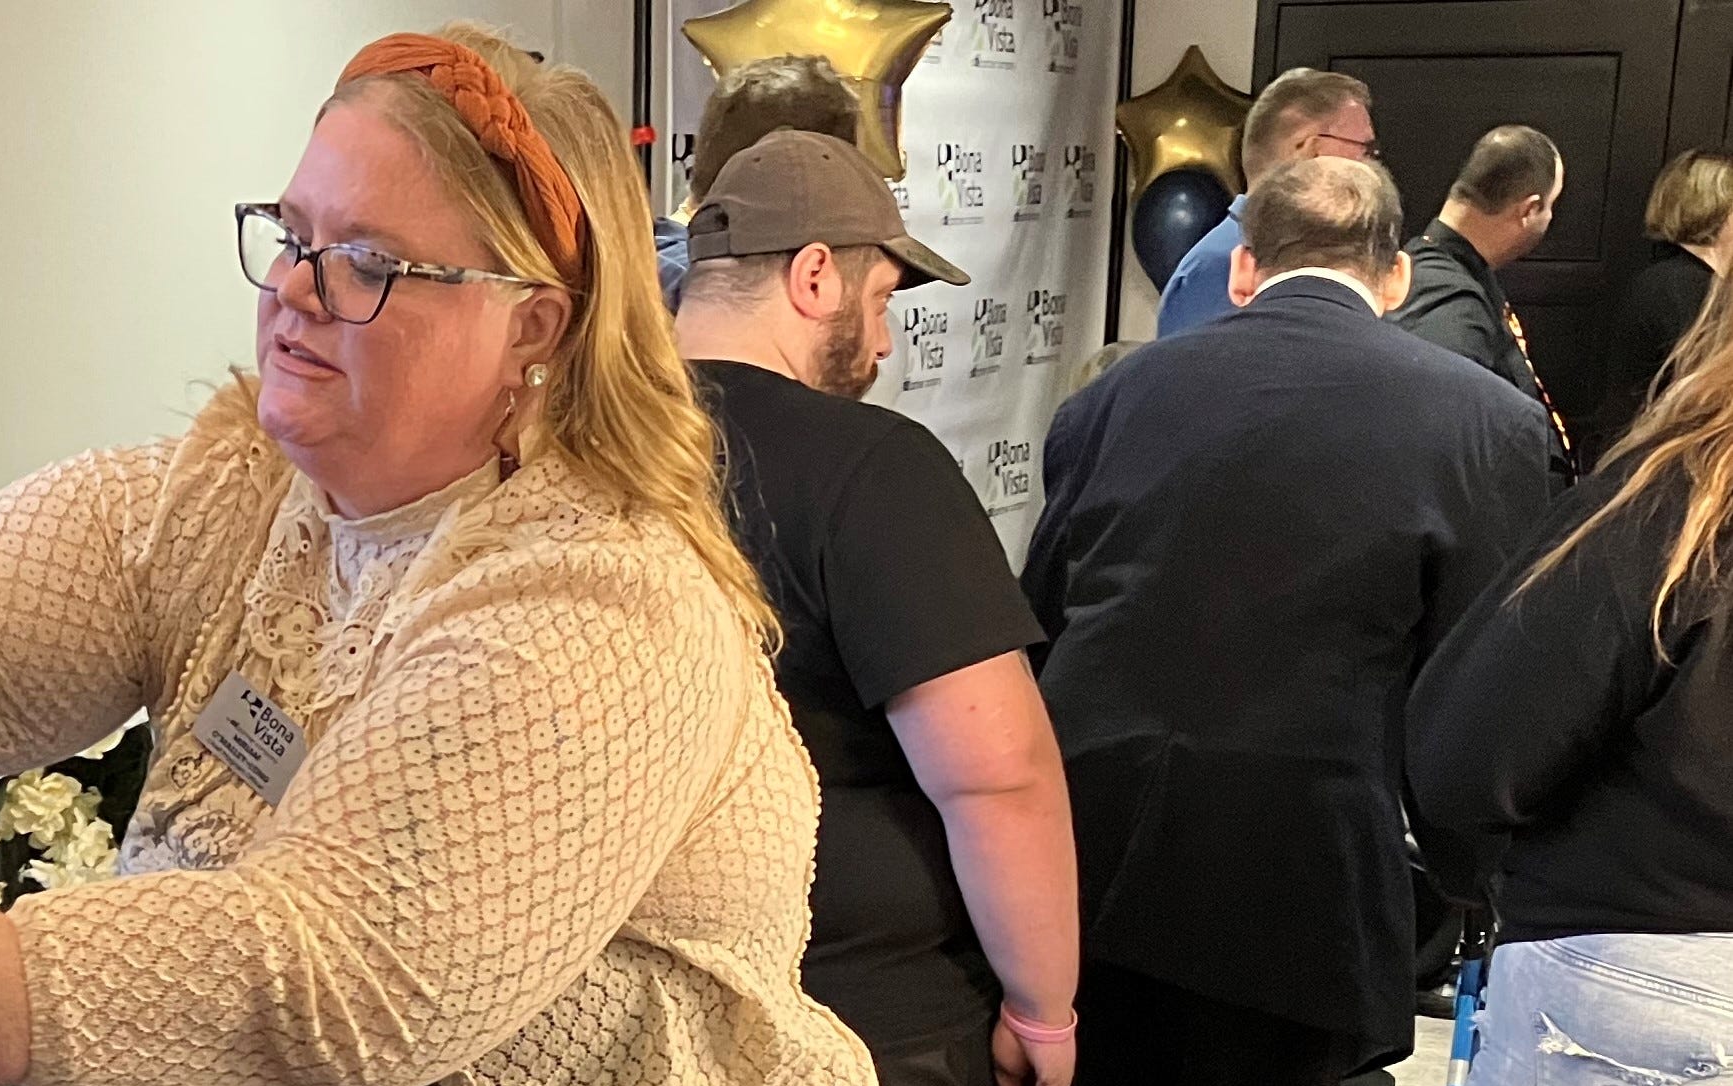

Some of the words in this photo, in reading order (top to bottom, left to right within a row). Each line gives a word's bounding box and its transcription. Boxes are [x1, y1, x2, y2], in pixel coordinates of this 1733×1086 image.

[988, 23, 1015, 53] Vista
[955, 144, 982, 173] Bona
[955, 178, 984, 208] Vista
[921, 306, 948, 336] Bona
[919, 340, 944, 371] Vista
[1001, 439, 1030, 467] Bona
[1001, 469, 1029, 496] Vista
[253, 721, 287, 758] Vista
[260, 707, 295, 745] Bona
